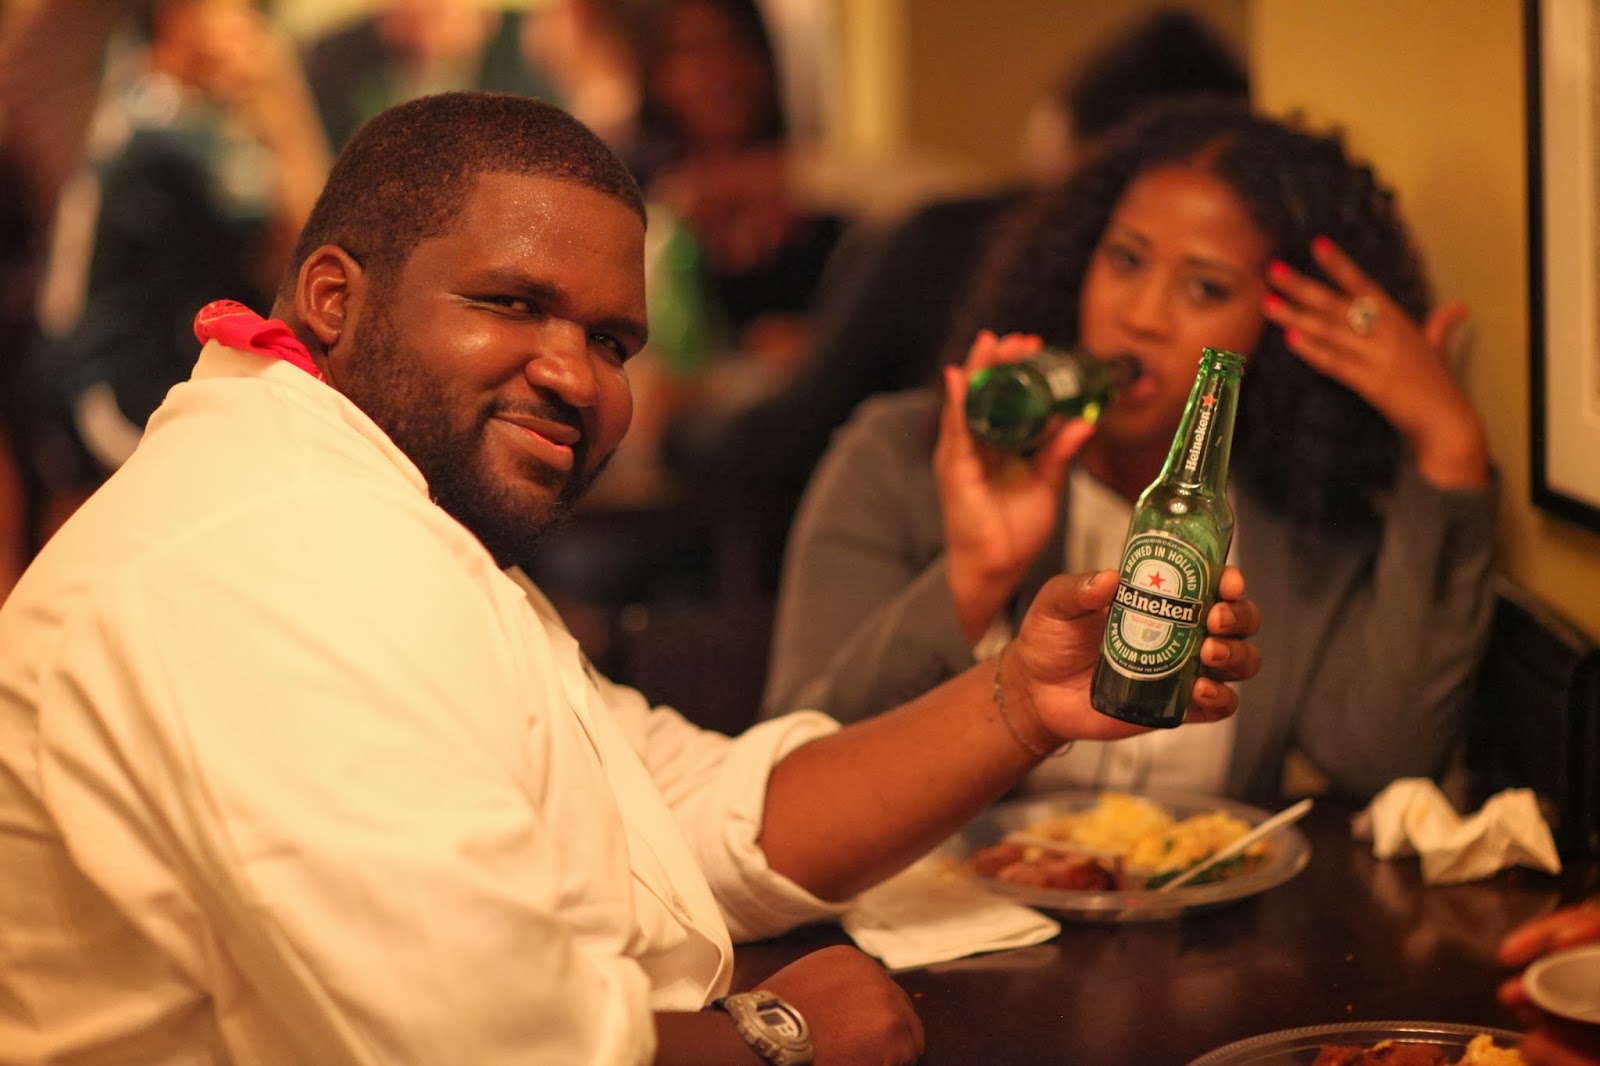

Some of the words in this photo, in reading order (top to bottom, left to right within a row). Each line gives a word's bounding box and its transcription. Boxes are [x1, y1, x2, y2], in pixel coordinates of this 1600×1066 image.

[1185, 410, 1211, 471] Heineken
[1125, 545, 1152, 573] BREWED
[1154, 546, 1165, 558] IN
[1168, 551, 1197, 591] HOLLAND
[1116, 584, 1194, 621] Heineken
[1111, 623, 1138, 663] PREMIUM
[1141, 640, 1181, 665] QUALITY
